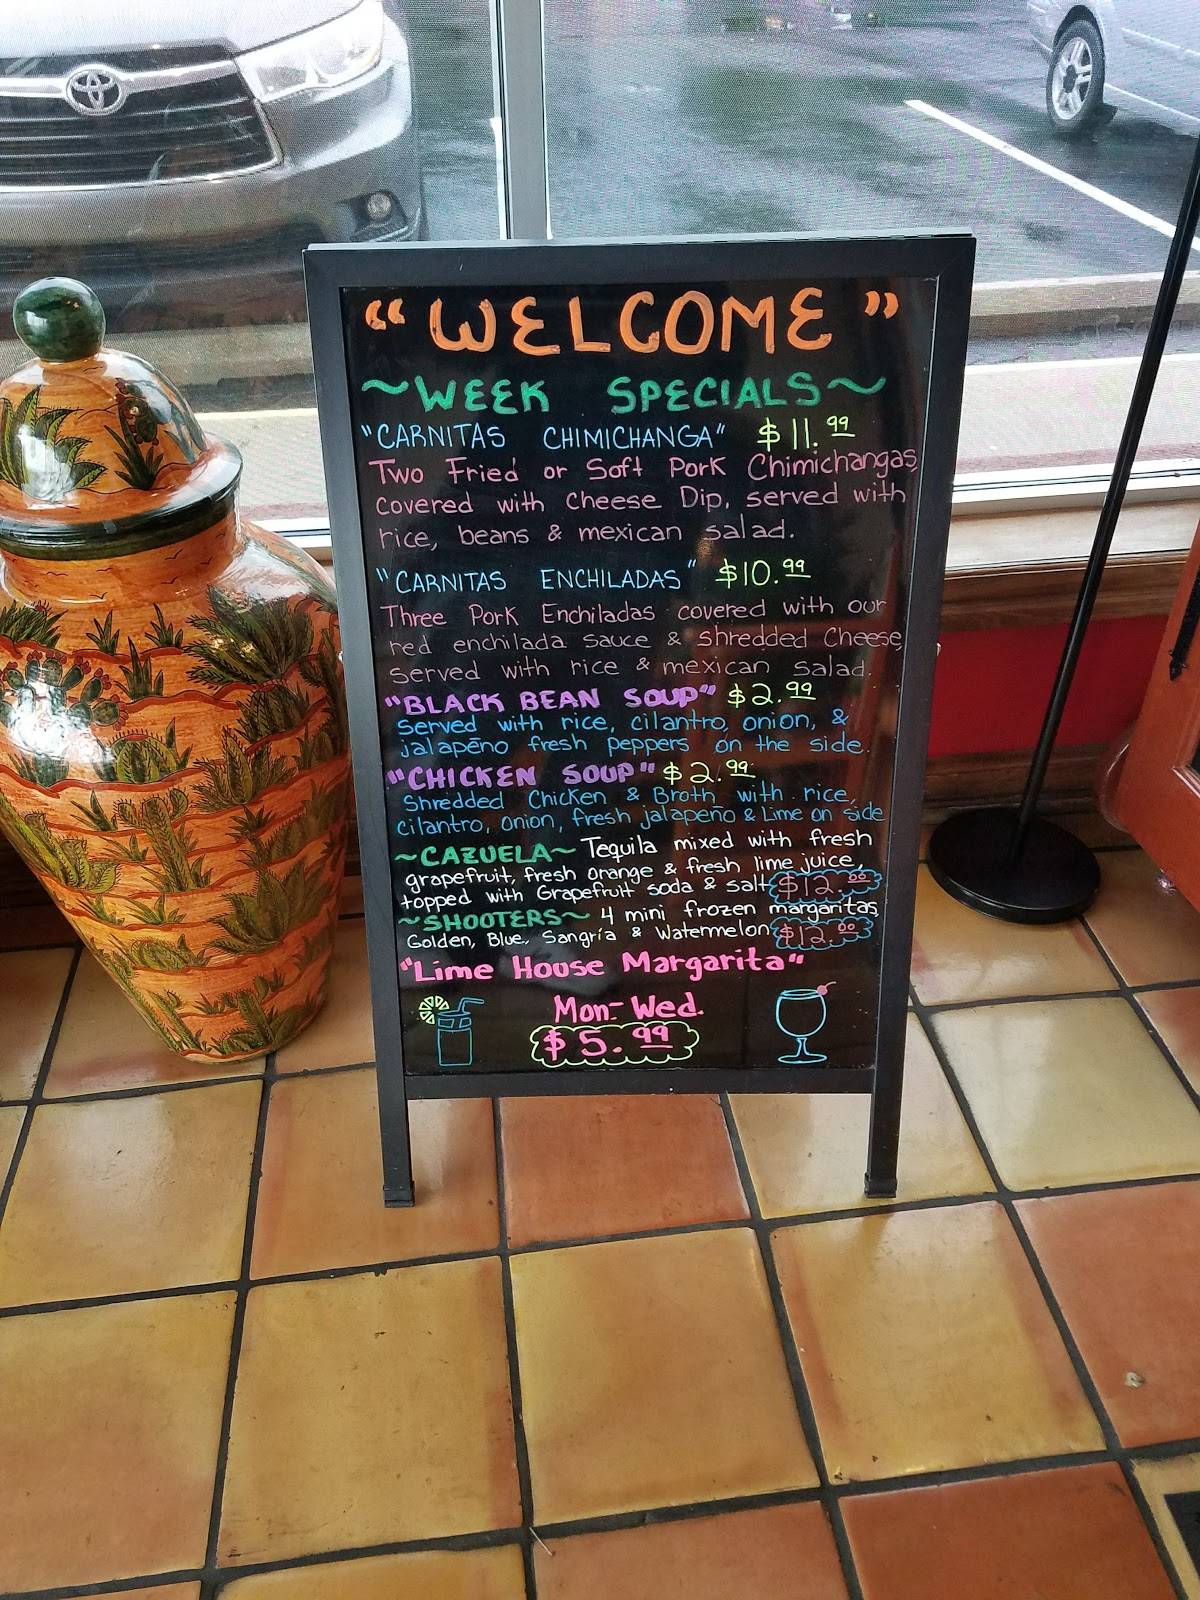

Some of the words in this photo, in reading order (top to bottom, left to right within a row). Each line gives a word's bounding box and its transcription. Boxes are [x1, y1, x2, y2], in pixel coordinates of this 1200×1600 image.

[368, 457, 424, 485] Two
[445, 456, 519, 485] Fried
[543, 464, 568, 480] or
[586, 455, 643, 481] Soft
[497, 490, 545, 514] with
[680, 485, 730, 512] Dip,
[854, 481, 906, 504] with
[379, 527, 438, 551] rice,
[458, 525, 529, 545] beans
[547, 523, 562, 542] &
[578, 523, 682, 542] mexican
[703, 513, 794, 541] salad.
[380, 604, 447, 627] Three
[542, 600, 655, 624] Enchiladas
[678, 599, 766, 621] covered
[783, 596, 833, 616] with
[848, 599, 887, 614] our
[390, 635, 432, 656] red
[453, 632, 567, 654] enchilada
[583, 633, 653, 649] sauce
[667, 631, 681, 646] &
[697, 624, 807, 650] shredded
[501, 656, 550, 679] with
[571, 658, 620, 676] rice
[636, 656, 650, 671] &
[663, 657, 770, 676] mexican
[519, 687, 600, 711] BEAN
[497, 713, 543, 733] with
[561, 711, 615, 733] rice,
[831, 707, 849, 726] &
[528, 733, 587, 751] fresh
[607, 736, 690, 757] peppers
[715, 738, 742, 753] on
[755, 734, 790, 753] the
[626, 786, 639, 801] &
[653, 786, 715, 804] Broth
[737, 780, 783, 803] with
[572, 806, 631, 828] fresh
[743, 808, 757, 822] &
[811, 808, 832, 822] on
[843, 800, 887, 823] side
[580, 834, 657, 864] Tequila
[674, 831, 735, 851] mixed
[748, 831, 793, 849] with
[808, 828, 872, 848] fresh
[524, 864, 576, 883] fresh
[664, 862, 677, 875] &
[686, 855, 741, 875] fresh
[754, 855, 795, 871] lime
[401, 887, 472, 912] topped
[486, 886, 523, 903] with
[647, 877, 694, 895] soda
[704, 876, 716, 890] &
[726, 873, 771, 892] salt
[601, 906, 614, 926] 4
[625, 903, 666, 922] mini
[683, 899, 757, 918] frozen
[631, 926, 642, 938] &
[512, 954, 605, 980] House
